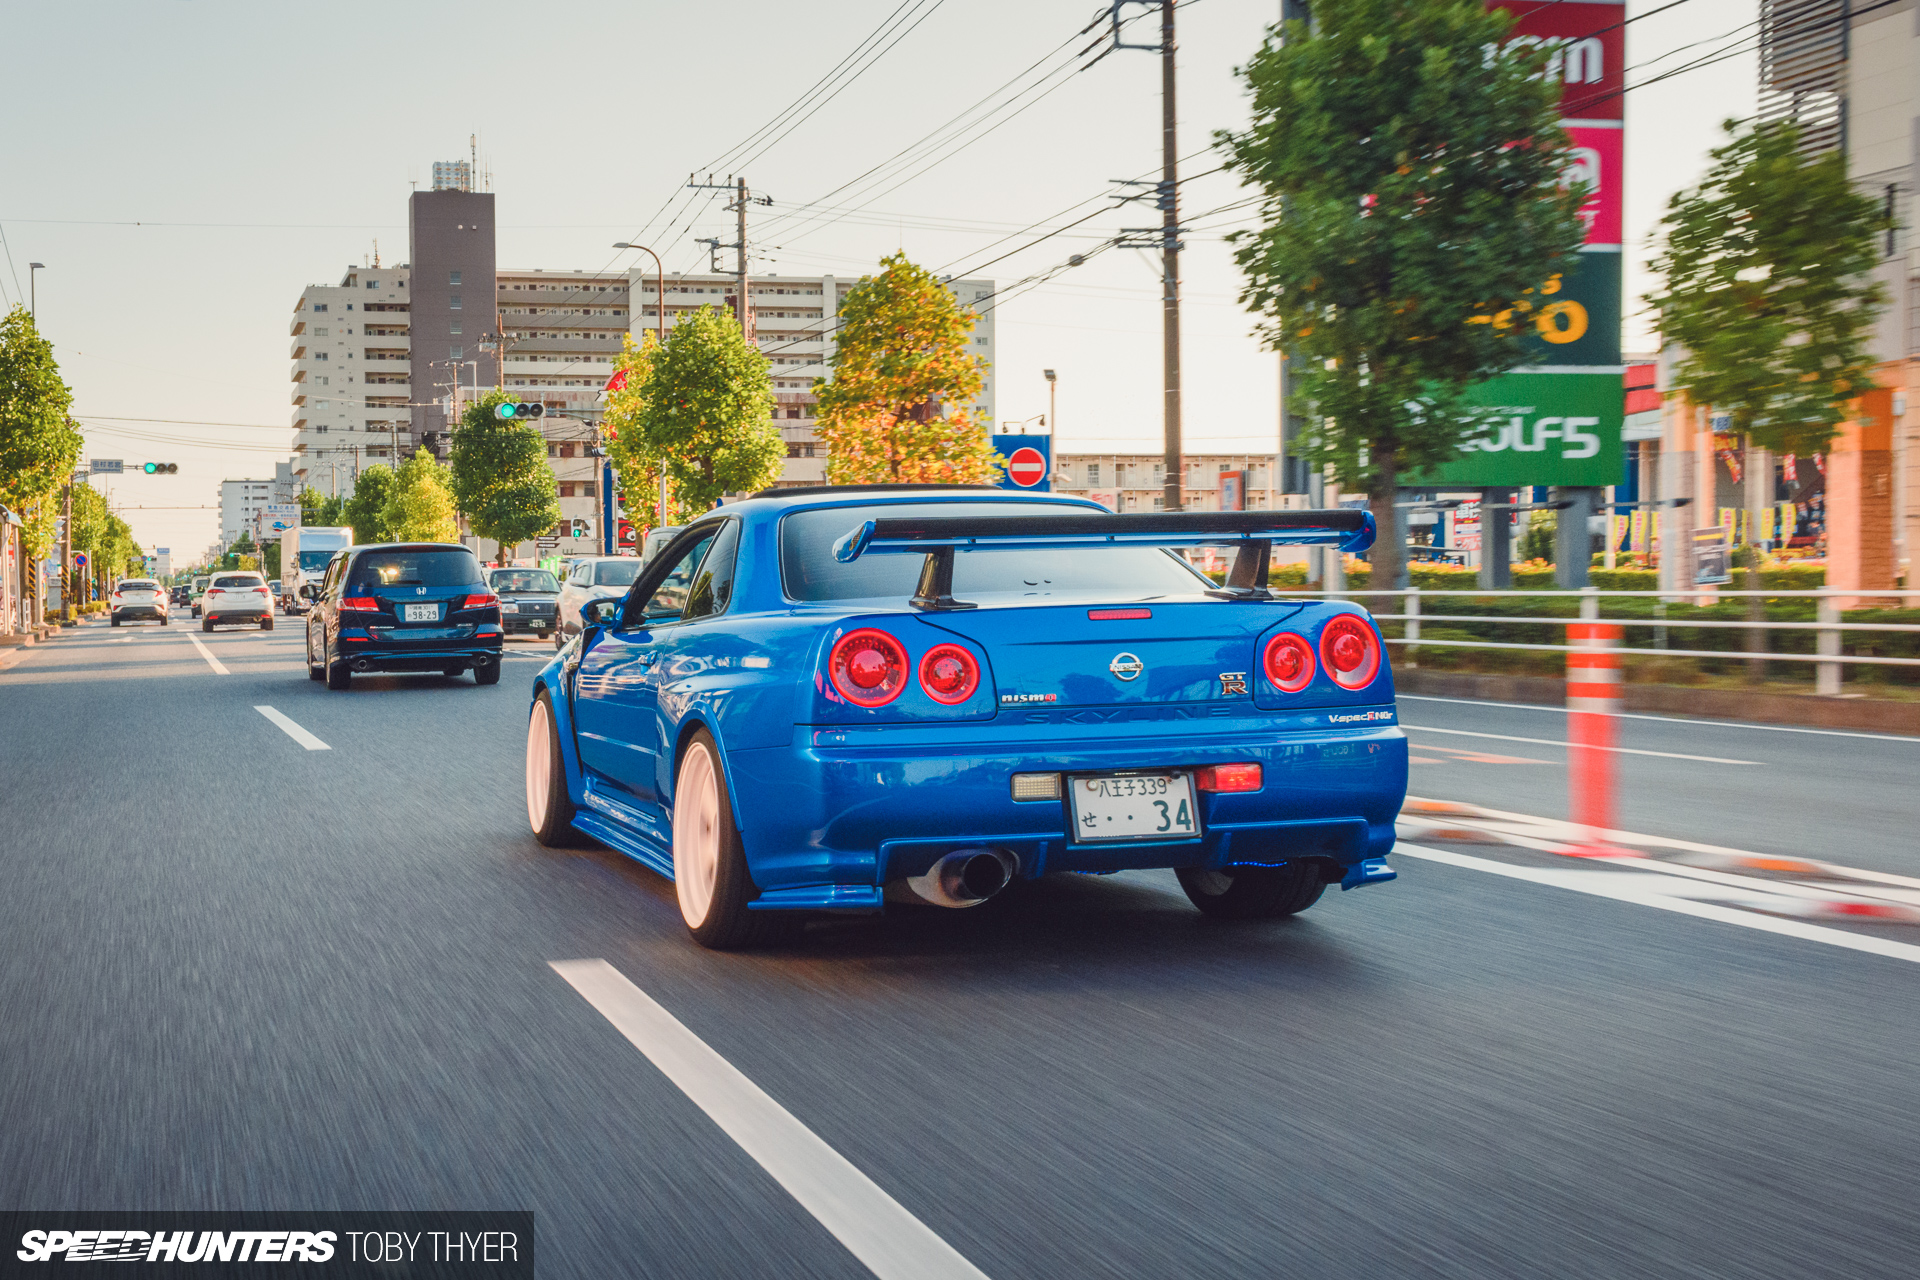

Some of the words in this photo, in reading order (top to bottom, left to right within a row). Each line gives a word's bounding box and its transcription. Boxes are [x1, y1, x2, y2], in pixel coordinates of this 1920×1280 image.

[412, 610, 437, 620] 98-29
[1219, 671, 1247, 681] GT
[1220, 680, 1249, 695] R
[1024, 706, 1231, 726] SKYLINE
[1081, 811, 1097, 828] せ
